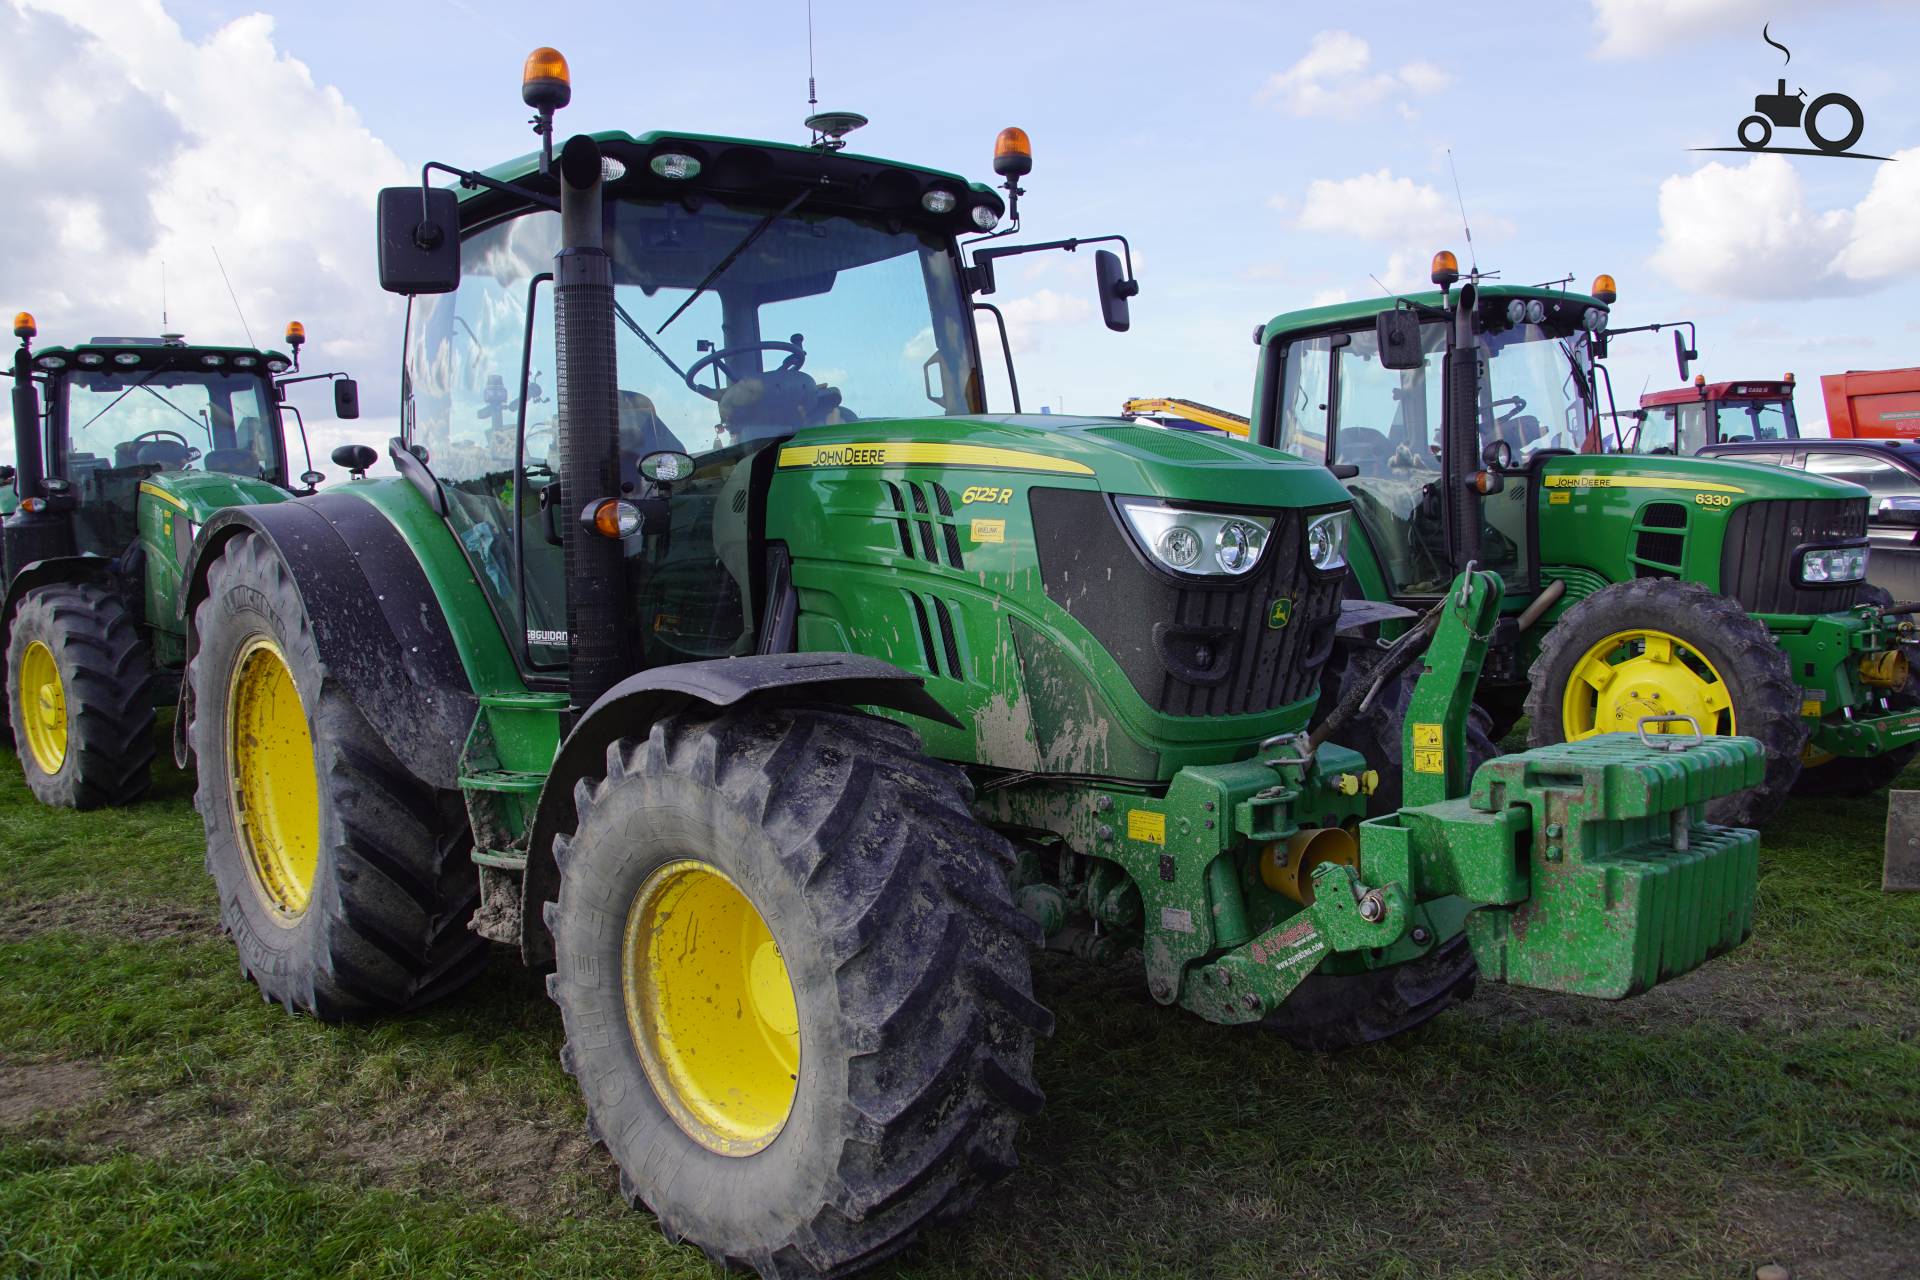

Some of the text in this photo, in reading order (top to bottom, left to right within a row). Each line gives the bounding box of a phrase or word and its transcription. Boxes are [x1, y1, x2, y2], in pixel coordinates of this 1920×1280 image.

[813, 447, 886, 465] JOHN DEERE
[1555, 477, 1611, 487] JOHN DEERE
[1695, 493, 1731, 507] 6330
